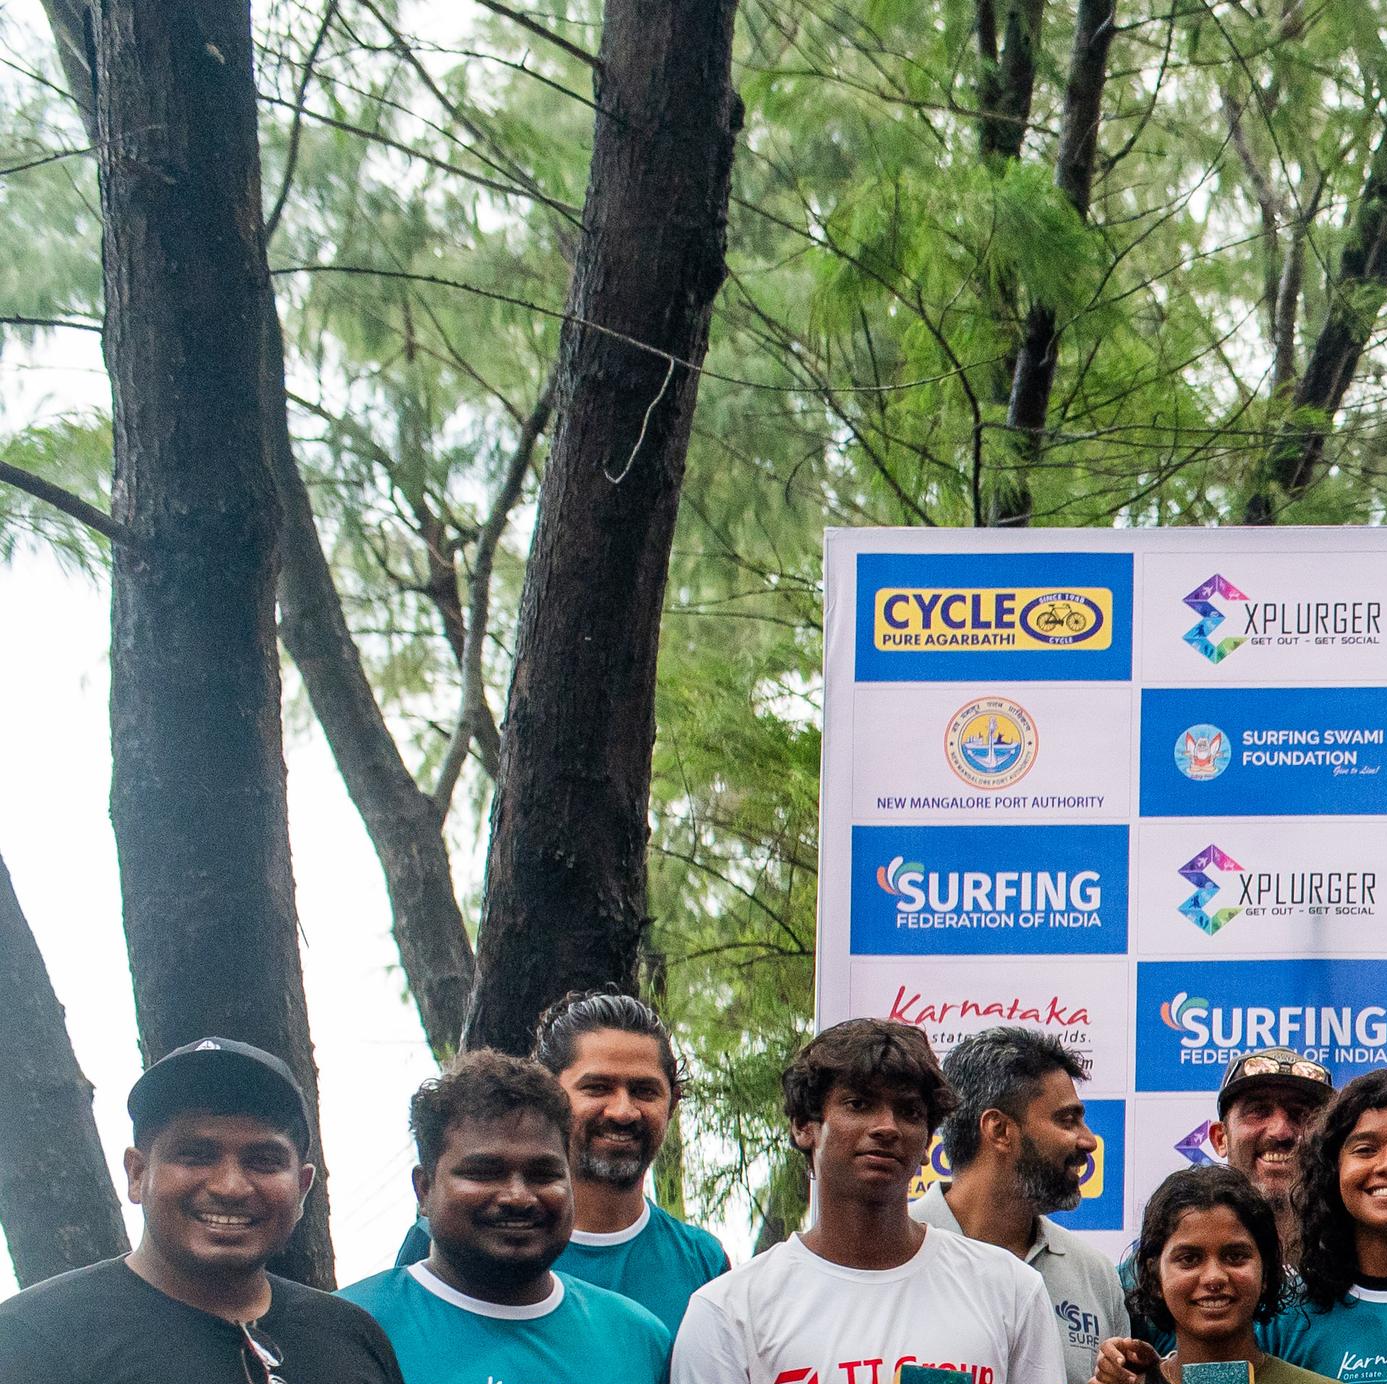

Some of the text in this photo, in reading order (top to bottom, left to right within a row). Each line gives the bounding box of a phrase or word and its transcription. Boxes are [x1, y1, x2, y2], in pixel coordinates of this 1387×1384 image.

[884, 594, 1015, 629] CYCLE
[883, 634, 1015, 646] PURE AGARBATHI
[1251, 636, 1379, 645] GET OUT GET SOCIAL
[1243, 730, 1383, 745] SURFING SWAMI
[1243, 751, 1357, 765] FOUNDATION
[877, 796, 1104, 809] NEW MANGALORE PORT AUTHORITY
[896, 872, 1100, 912] SURFING
[897, 912, 1101, 928] FEDERATION OF INDIA
[887, 986, 1089, 1030] Karnataka
[1180, 1003, 1387, 1047] SURFING
